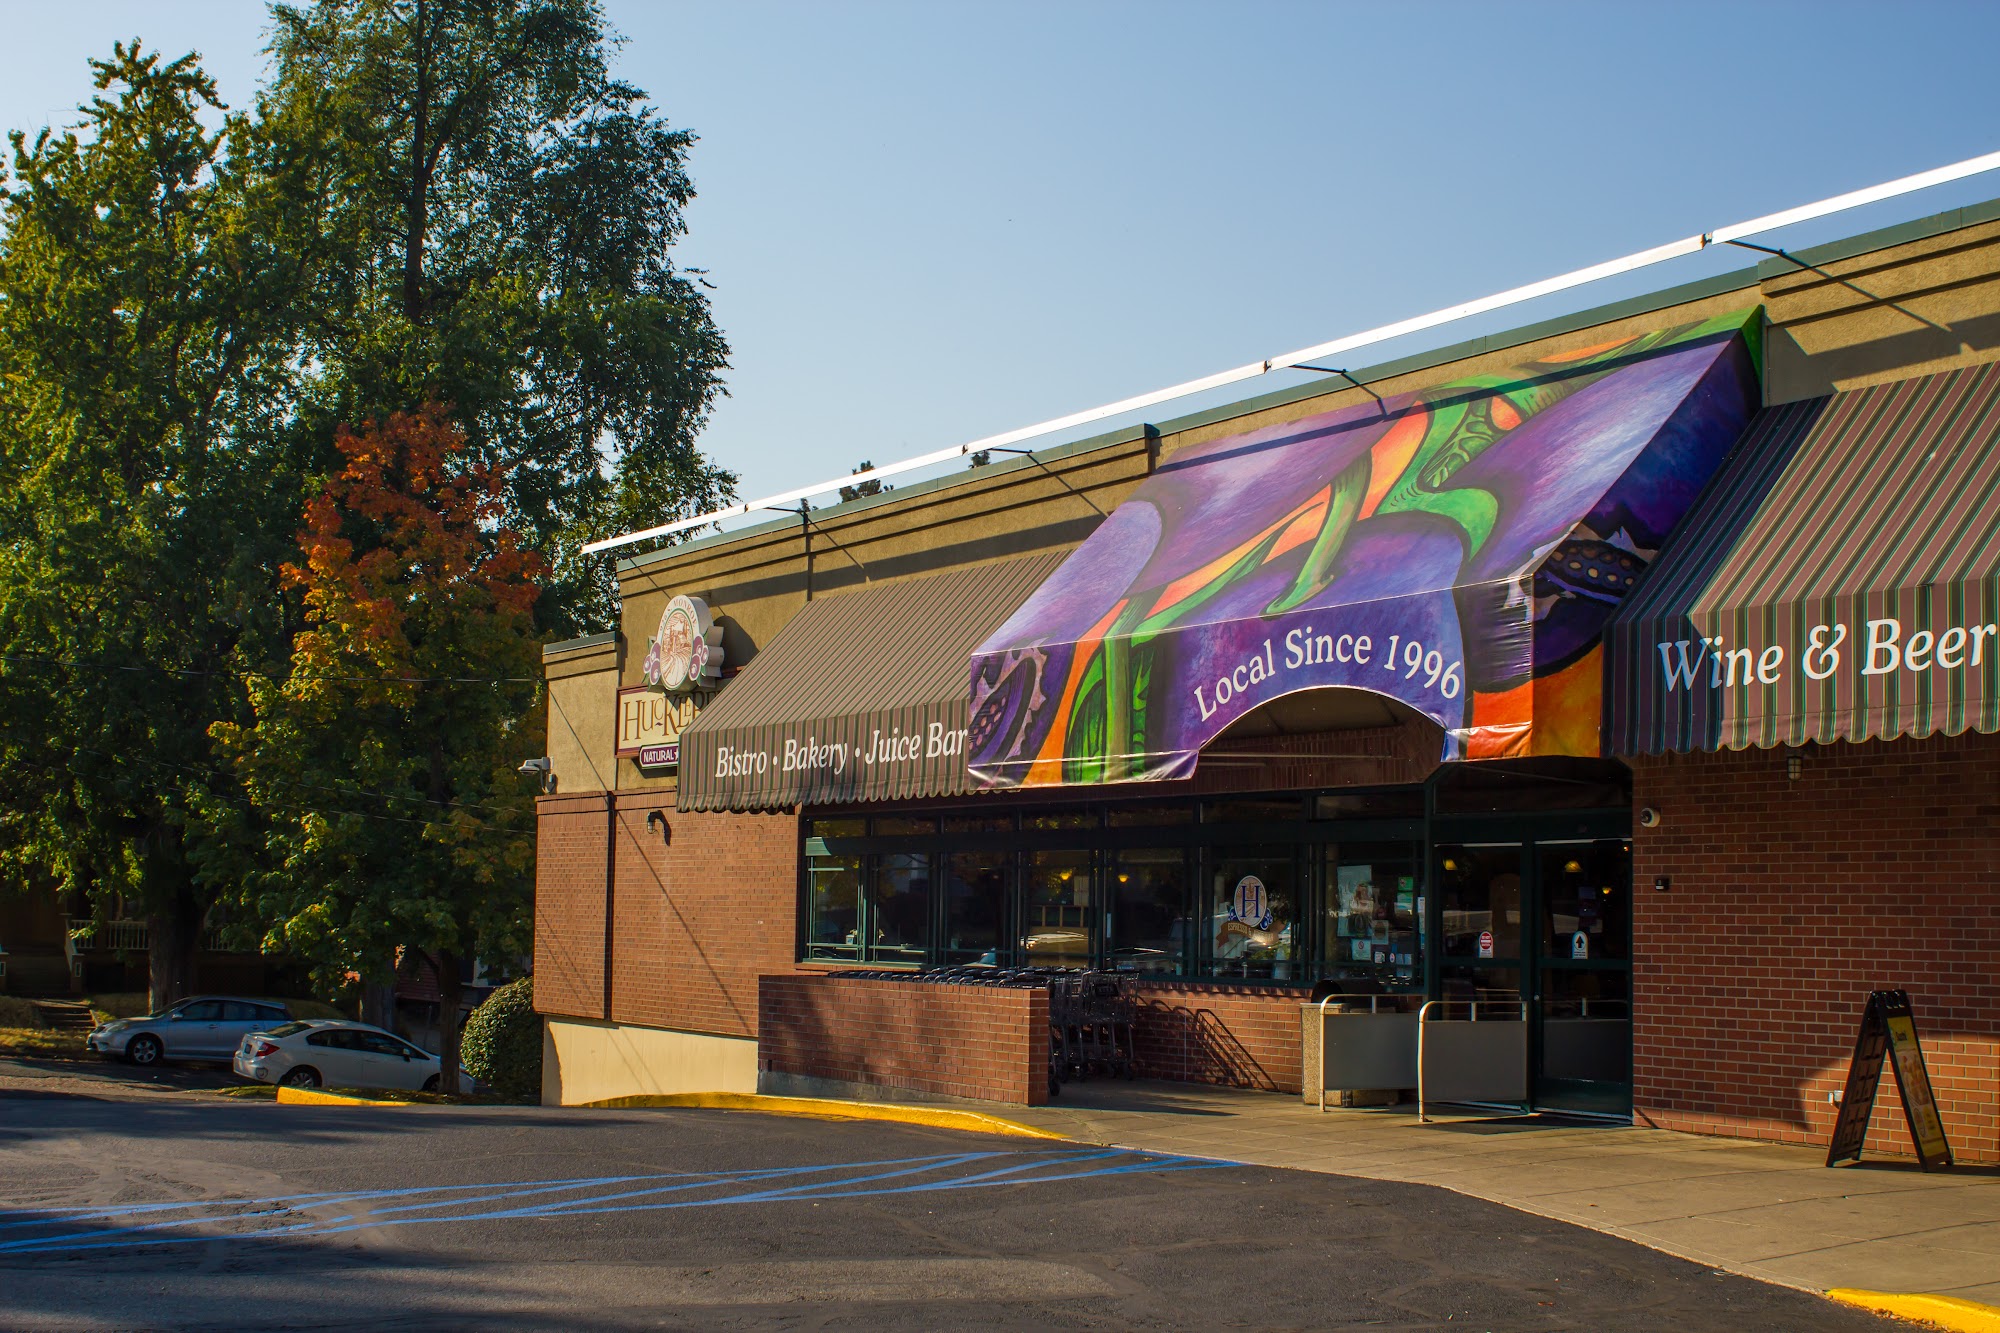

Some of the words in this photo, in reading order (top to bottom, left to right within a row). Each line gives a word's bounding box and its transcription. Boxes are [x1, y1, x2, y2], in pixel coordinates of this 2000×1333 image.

[673, 598, 697, 627] MONROE
[1193, 638, 1276, 722] Local
[1285, 626, 1372, 669] Since
[1383, 635, 1461, 699] 1996
[1657, 635, 1784, 692] Wine
[1802, 623, 1847, 680] &
[1861, 618, 1997, 675] Beer
[643, 749, 675, 763] NATURAL
[715, 745, 767, 778] Bistro
[782, 736, 848, 775] Bakery
[865, 727, 921, 765] Juice
[926, 721, 968, 758] Bar
[1241, 886, 1260, 918] H
